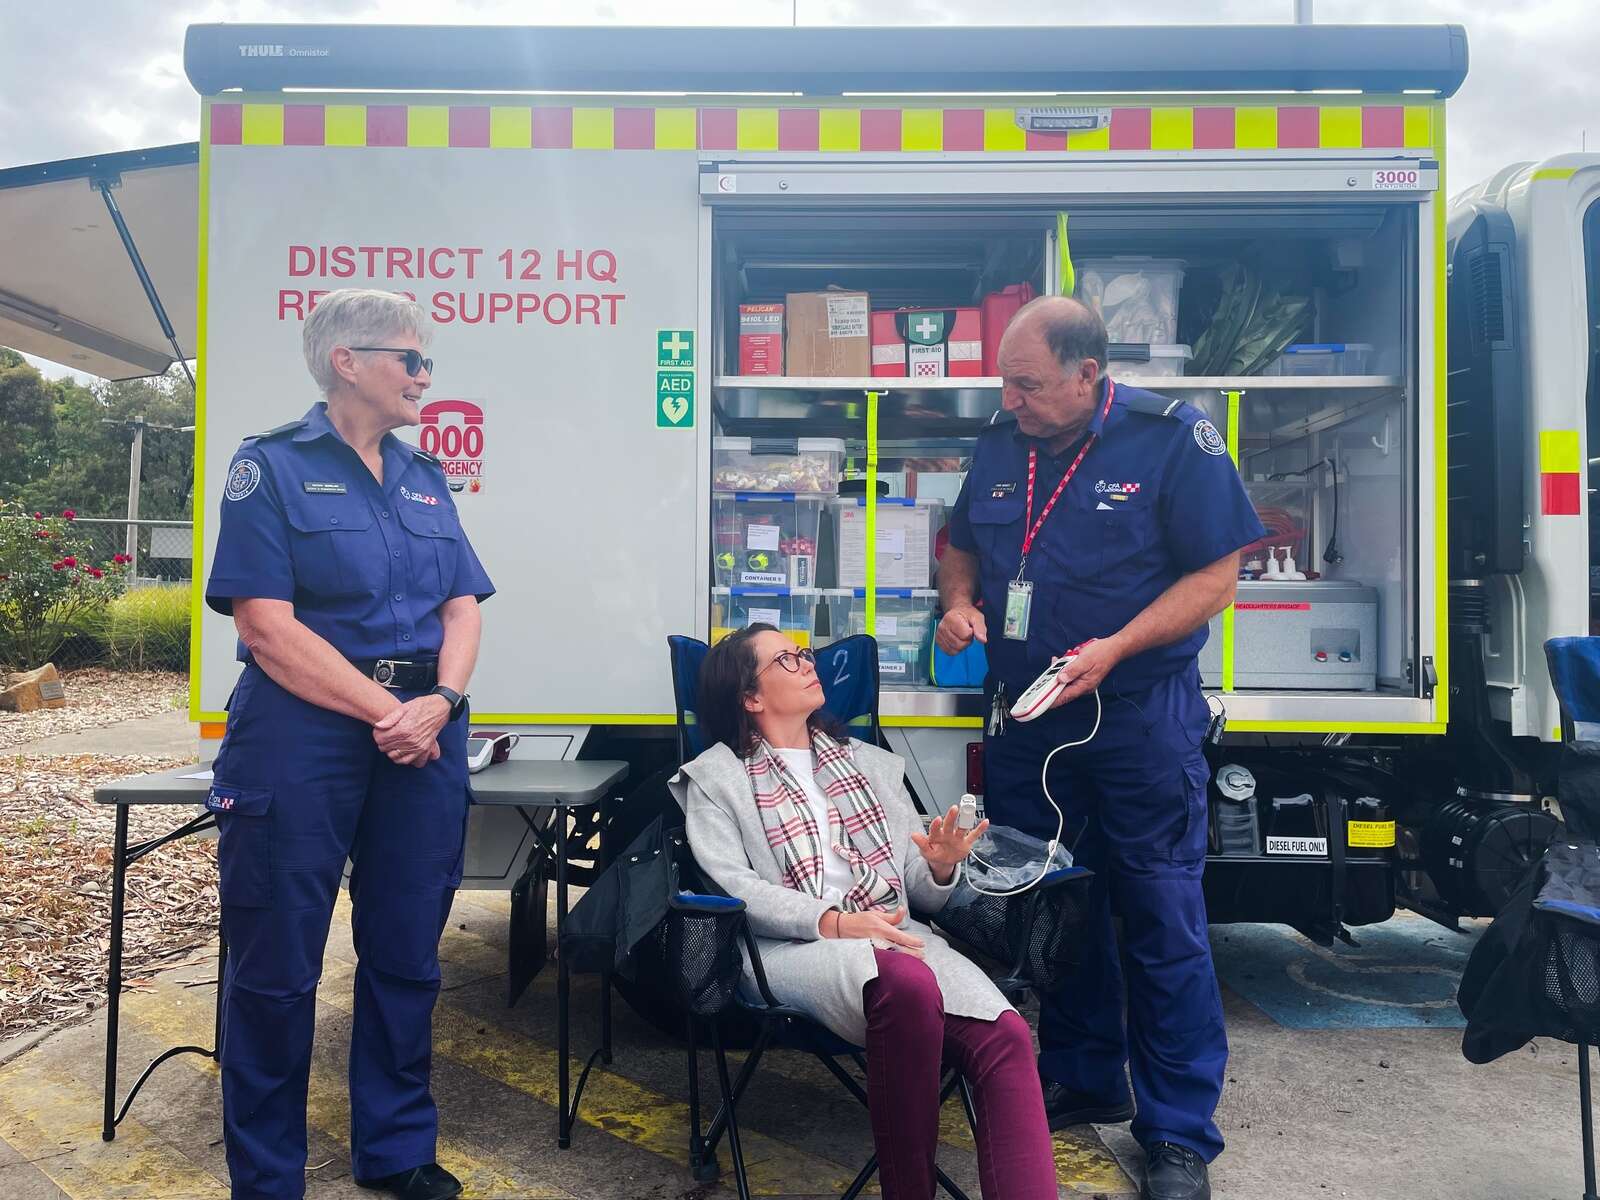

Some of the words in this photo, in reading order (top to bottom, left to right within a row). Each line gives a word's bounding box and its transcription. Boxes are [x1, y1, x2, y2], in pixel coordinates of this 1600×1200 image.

[239, 44, 284, 57] THULE
[289, 48, 329, 57] Omnistor
[1376, 171, 1417, 183] 3000
[288, 245, 484, 279] DISTRICT
[498, 248, 542, 281] 12
[556, 249, 618, 284] HQ
[431, 291, 626, 326] SUPPORT
[660, 378, 691, 392] AED
[420, 425, 484, 458] 000
[441, 461, 483, 475] RGENCY
[832, 649, 851, 686] 2
[1269, 840, 1291, 851] DIESEL
[1292, 841, 1308, 852] FUEL
[1308, 841, 1326, 852] ONLY
